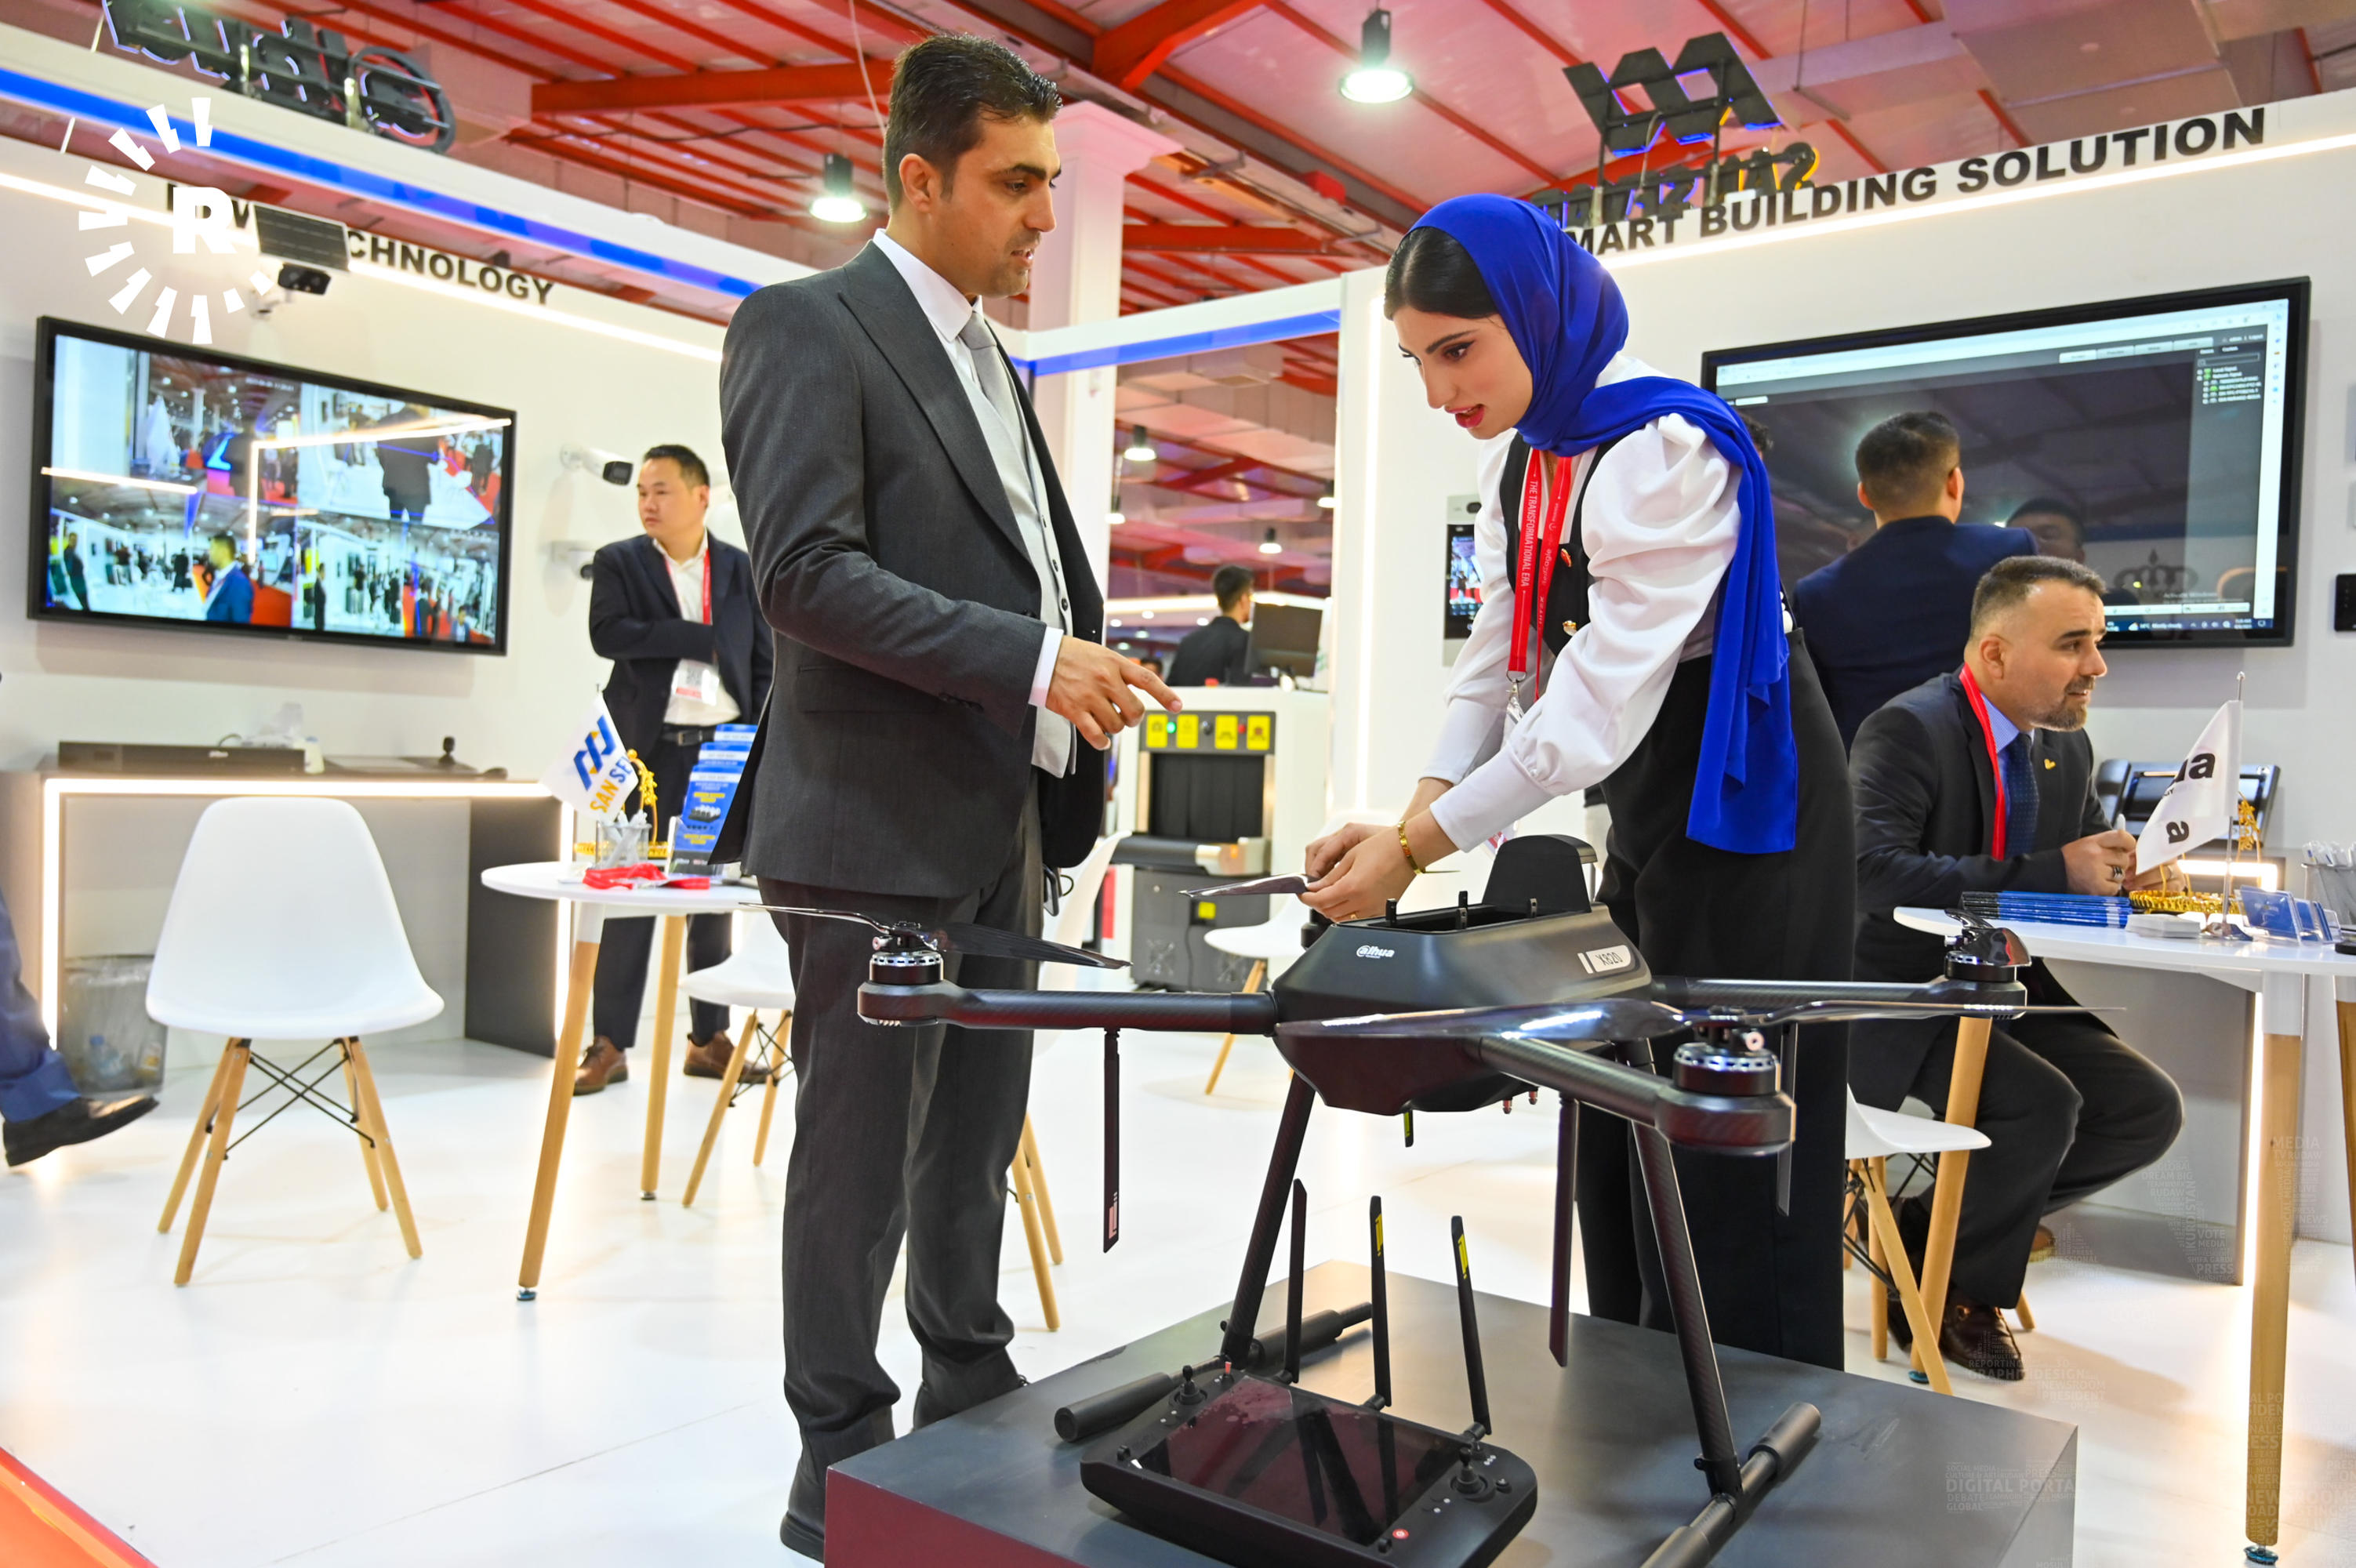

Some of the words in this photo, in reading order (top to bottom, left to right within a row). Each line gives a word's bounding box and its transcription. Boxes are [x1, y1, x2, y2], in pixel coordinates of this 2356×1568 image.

[1566, 213, 1684, 256] MART
[1700, 166, 1937, 238] BUILDING
[1956, 107, 2265, 194] SOLUTION
[348, 230, 554, 306] CHNOLOGY
[1529, 480, 1538, 495] THE
[1523, 495, 1537, 572] TRANSFORMATIONAL
[1520, 572, 1531, 588] ERA
[1595, 951, 1624, 967] X820
